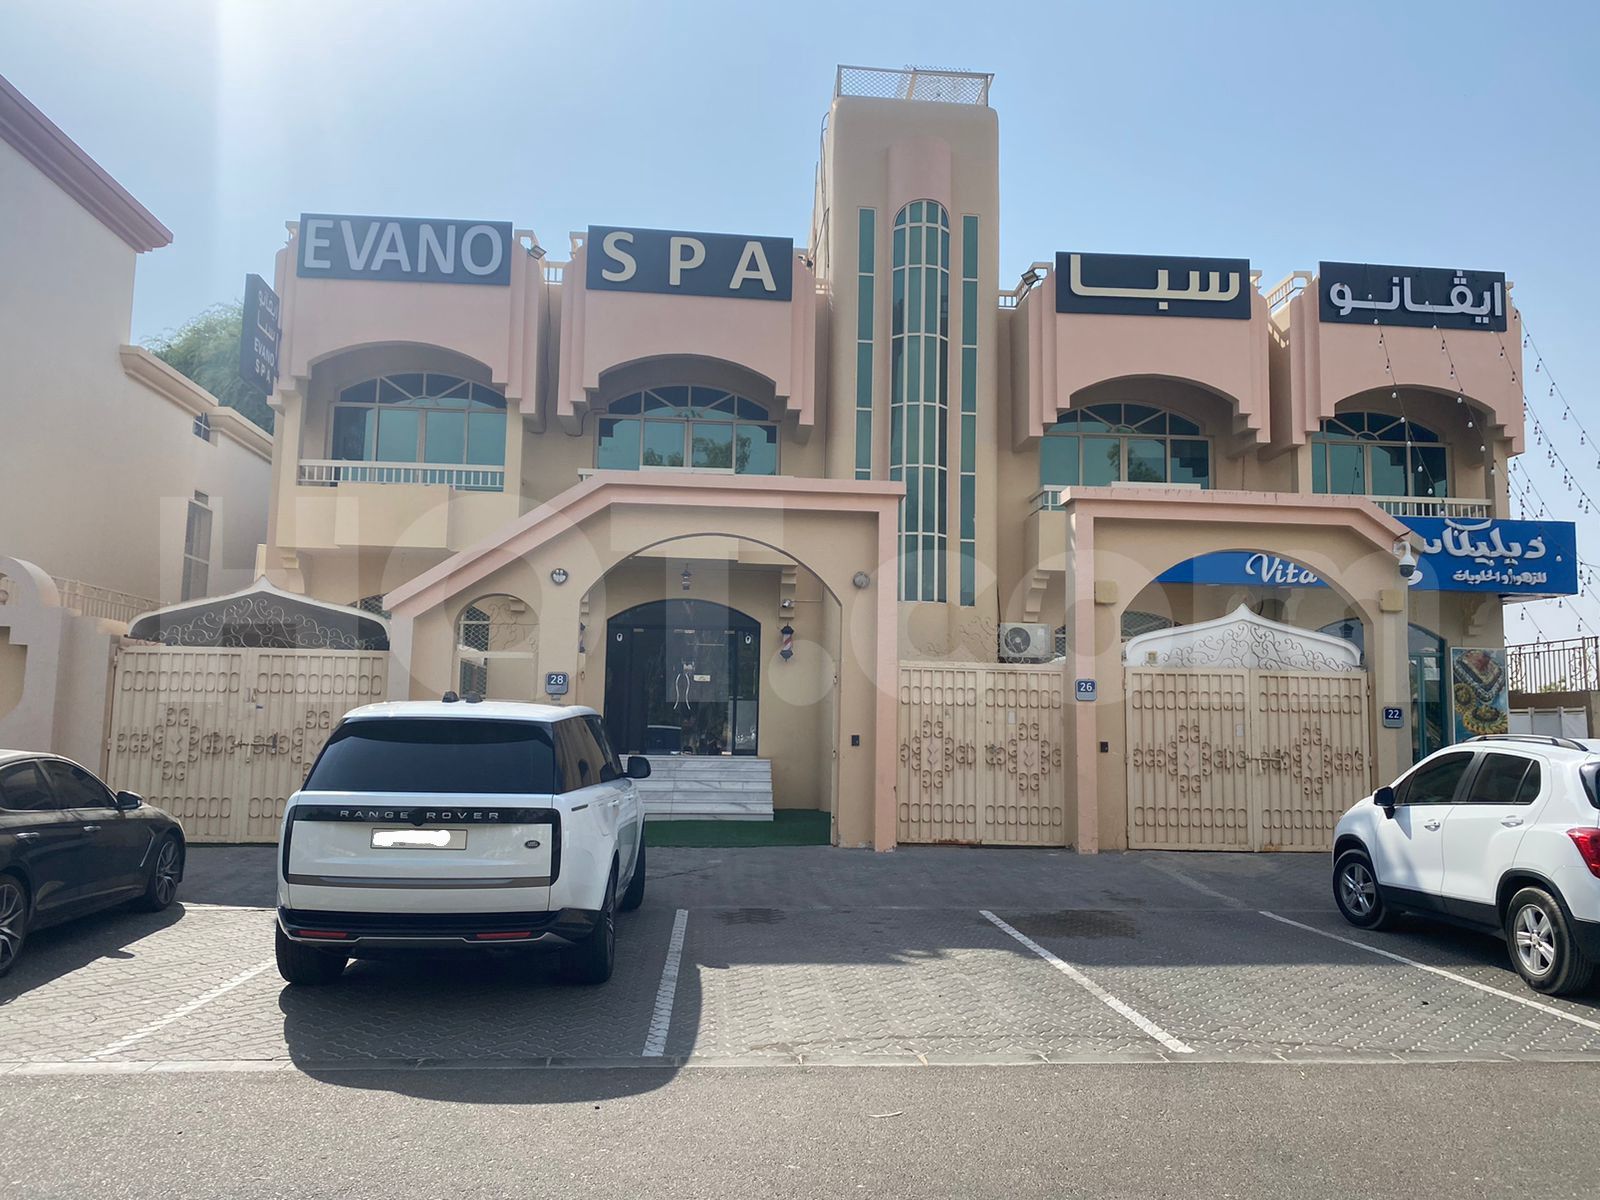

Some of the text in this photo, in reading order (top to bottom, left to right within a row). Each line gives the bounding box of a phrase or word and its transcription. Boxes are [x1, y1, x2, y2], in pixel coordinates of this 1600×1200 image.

[303, 218, 503, 277] EVANO
[601, 231, 777, 292] SPA
[1070, 254, 1240, 310] سبا
[254, 336, 275, 367] EVANO
[255, 358, 271, 384] SPA
[550, 674, 564, 685] 28
[1080, 682, 1093, 692] 26
[1388, 709, 1400, 719] 22
[339, 810, 499, 820] RANGE ROVER
